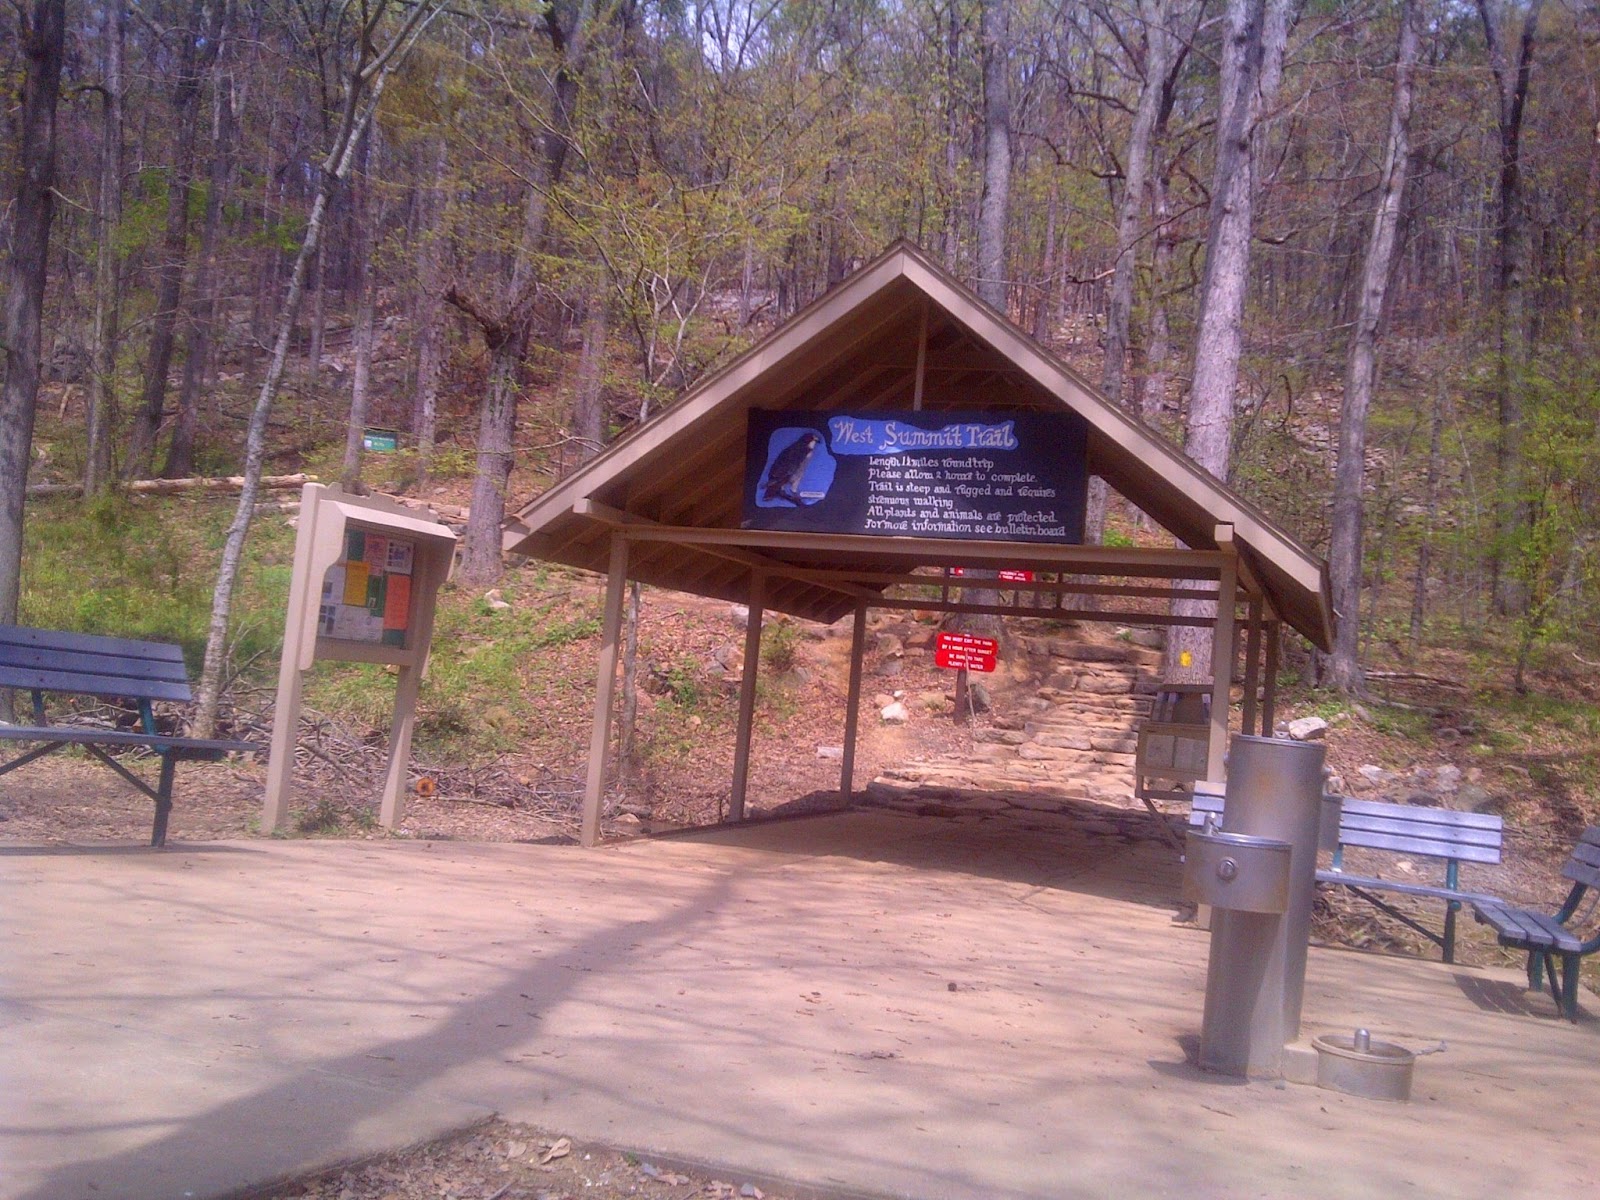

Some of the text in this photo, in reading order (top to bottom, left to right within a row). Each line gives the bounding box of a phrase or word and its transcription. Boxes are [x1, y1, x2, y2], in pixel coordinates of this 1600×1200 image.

[834, 421, 1014, 450] West Summit Trail
[869, 456, 900, 470] Length
[868, 468, 901, 480] Please
[905, 470, 933, 479] allow
[936, 471, 941, 479] 2
[945, 471, 972, 481] hours
[976, 471, 985, 481] to
[868, 481, 1055, 497] Trail is steep and rugged and requires
[868, 495, 953, 510] strenuous walking
[867, 506, 884, 516] All
[885, 507, 916, 519] plants
[920, 508, 939, 518] and
[943, 509, 982, 520] animals
[987, 512, 1001, 520] are
[884, 521, 908, 530] more
[912, 518, 971, 533] information
[975, 525, 993, 533] see
[1037, 525, 1066, 536] board
